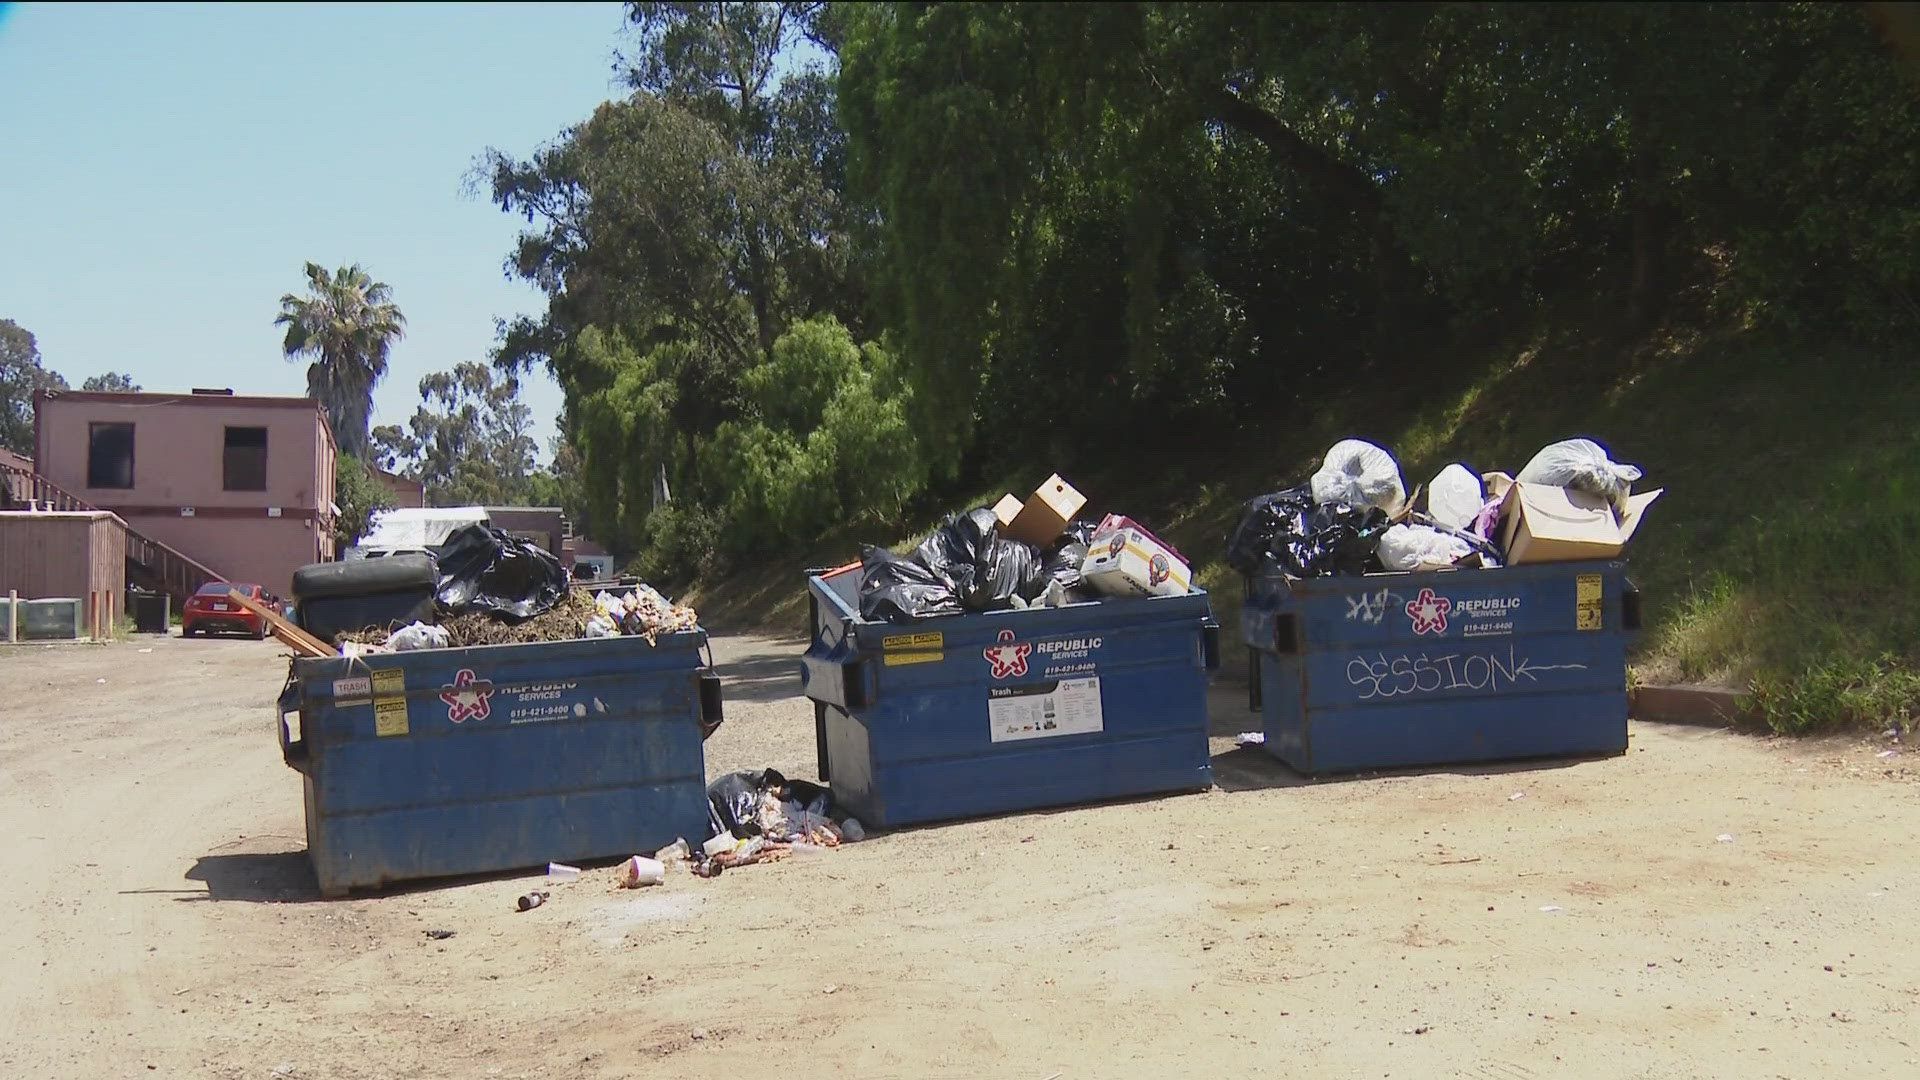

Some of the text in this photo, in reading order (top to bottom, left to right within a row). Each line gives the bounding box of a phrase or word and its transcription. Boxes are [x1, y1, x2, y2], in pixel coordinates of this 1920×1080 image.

[1456, 597, 1521, 611] REPUBLIC
[1471, 609, 1507, 618] SERVICES
[1037, 637, 1102, 654] REPUBLIC
[1052, 650, 1088, 660] SERVICES
[1045, 662, 1096, 675] 619-421-9400
[336, 681, 368, 692] TRASH
[991, 687, 1012, 697] Trash
[518, 691, 562, 702] SERVICES
[510, 705, 569, 718] 619-421-9400
